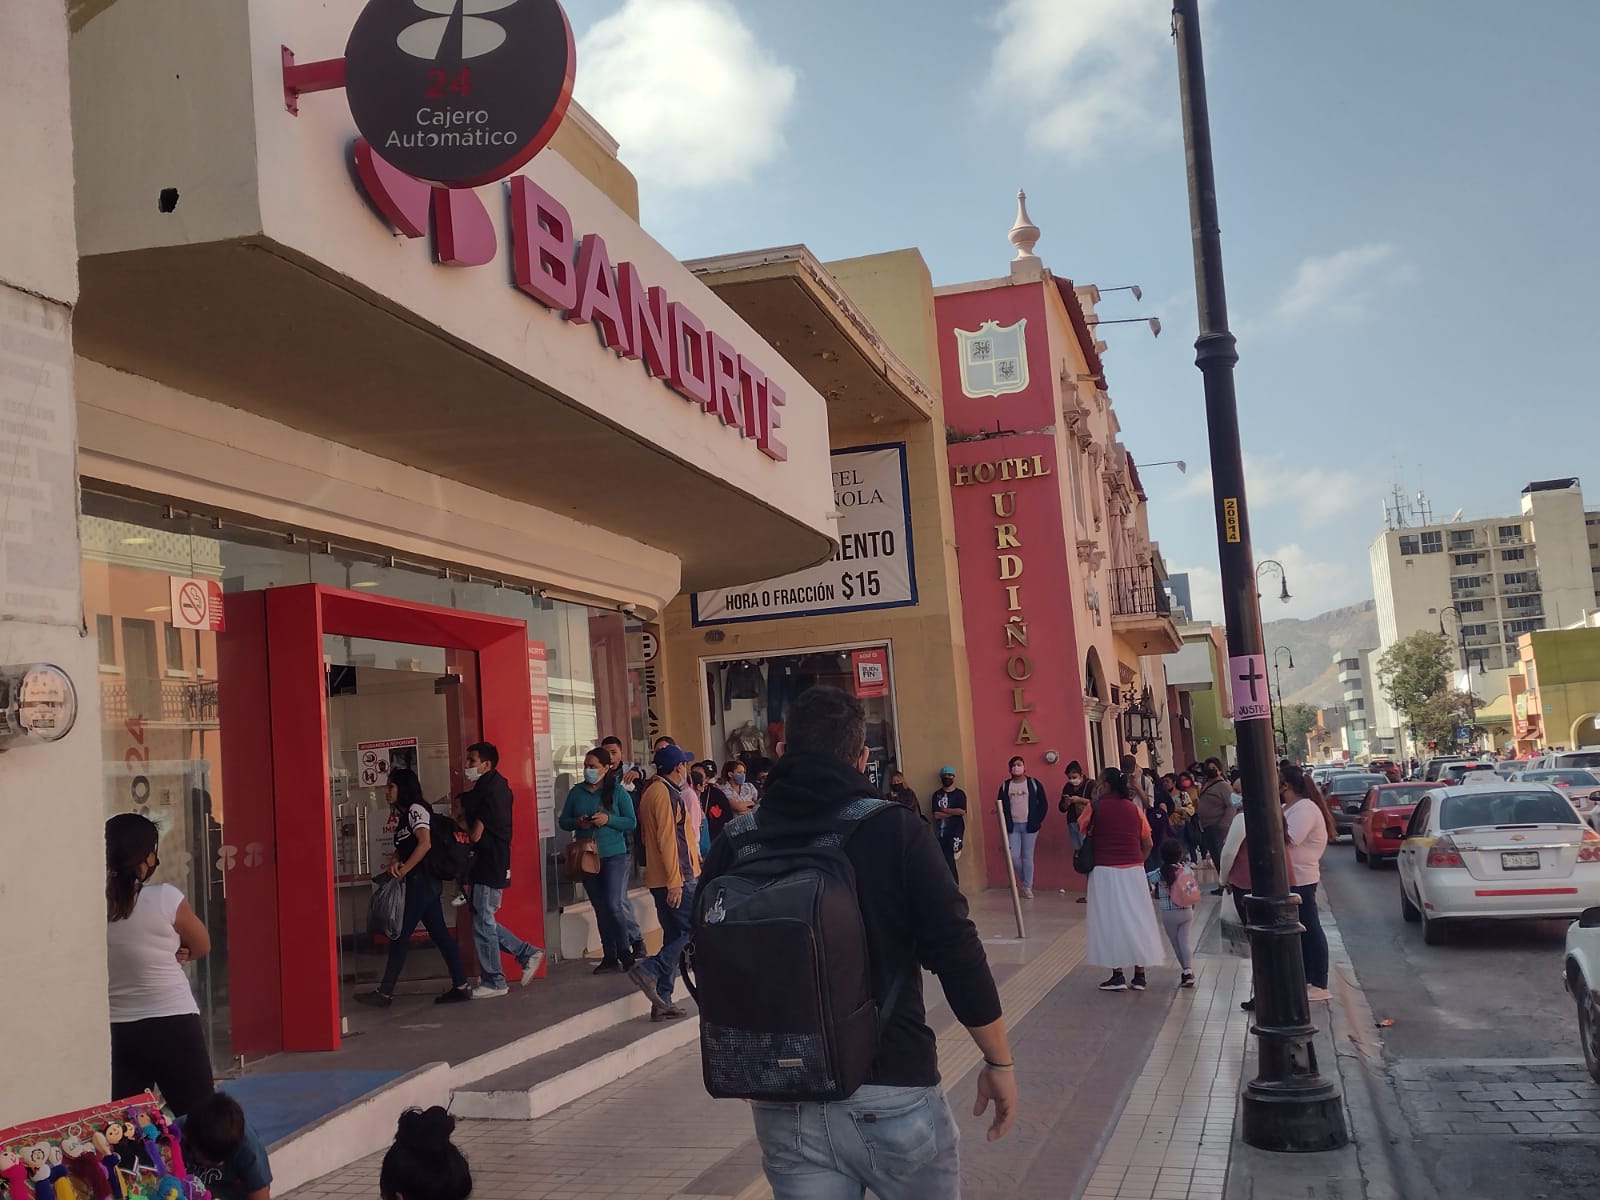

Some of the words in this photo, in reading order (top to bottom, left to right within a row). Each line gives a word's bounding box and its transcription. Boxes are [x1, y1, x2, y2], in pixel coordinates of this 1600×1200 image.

[425, 67, 471, 97] 24
[416, 107, 489, 128] Cajero
[385, 128, 518, 147] Automático
[511, 175, 788, 462] BANORTE
[831, 469, 864, 487] TEL
[953, 454, 1051, 486] HOTEL
[833, 489, 884, 507] OLA
[830, 530, 895, 561] ENTO
[725, 592, 759, 611] HORA
[762, 591, 770, 607] O
[773, 582, 835, 607] FRACCIÓN
[841, 570, 881, 601] $15
[991, 491, 1040, 745] URDIÑOLA
[1238, 704, 1269, 715] JUSTIC
